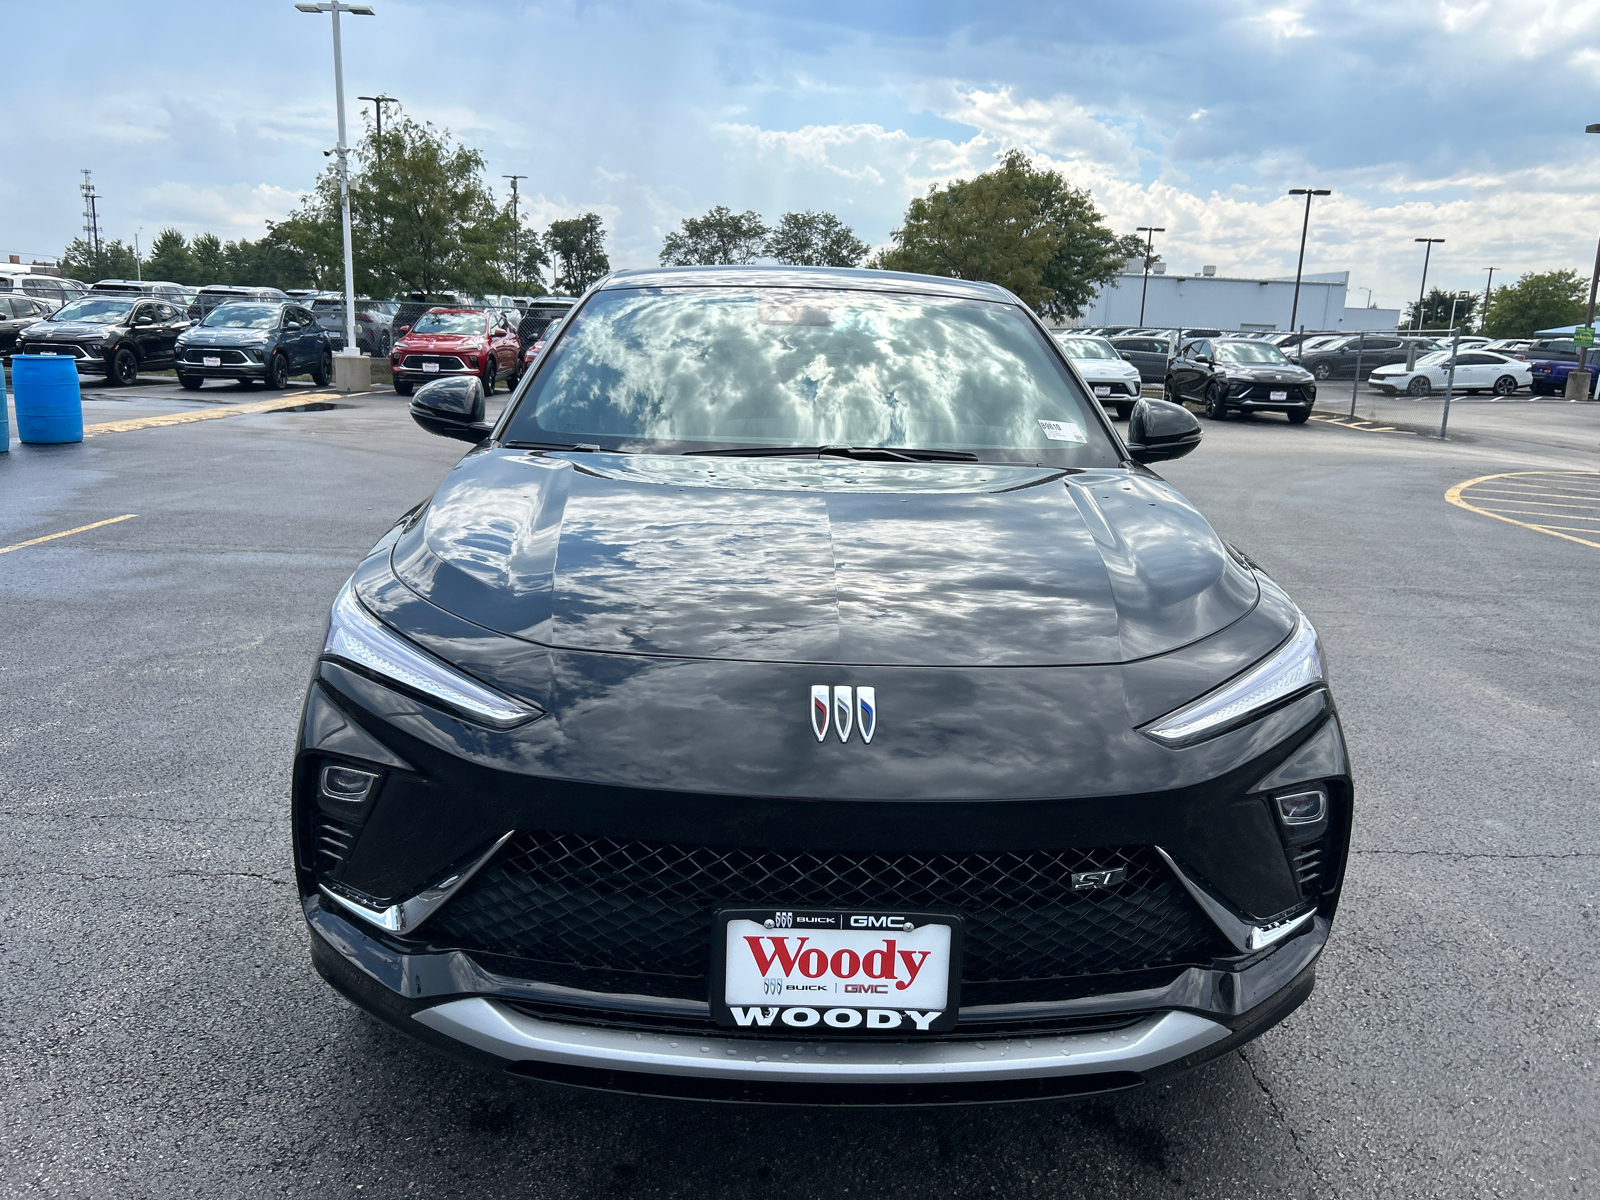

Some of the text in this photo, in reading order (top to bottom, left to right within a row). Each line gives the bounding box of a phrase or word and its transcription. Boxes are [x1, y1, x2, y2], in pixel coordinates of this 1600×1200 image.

[1074, 868, 1124, 889] ST
[796, 915, 905, 928] BUICK GMC
[743, 936, 931, 990] Woody
[844, 984, 888, 994] GMC
[729, 1006, 942, 1030] WOODY
